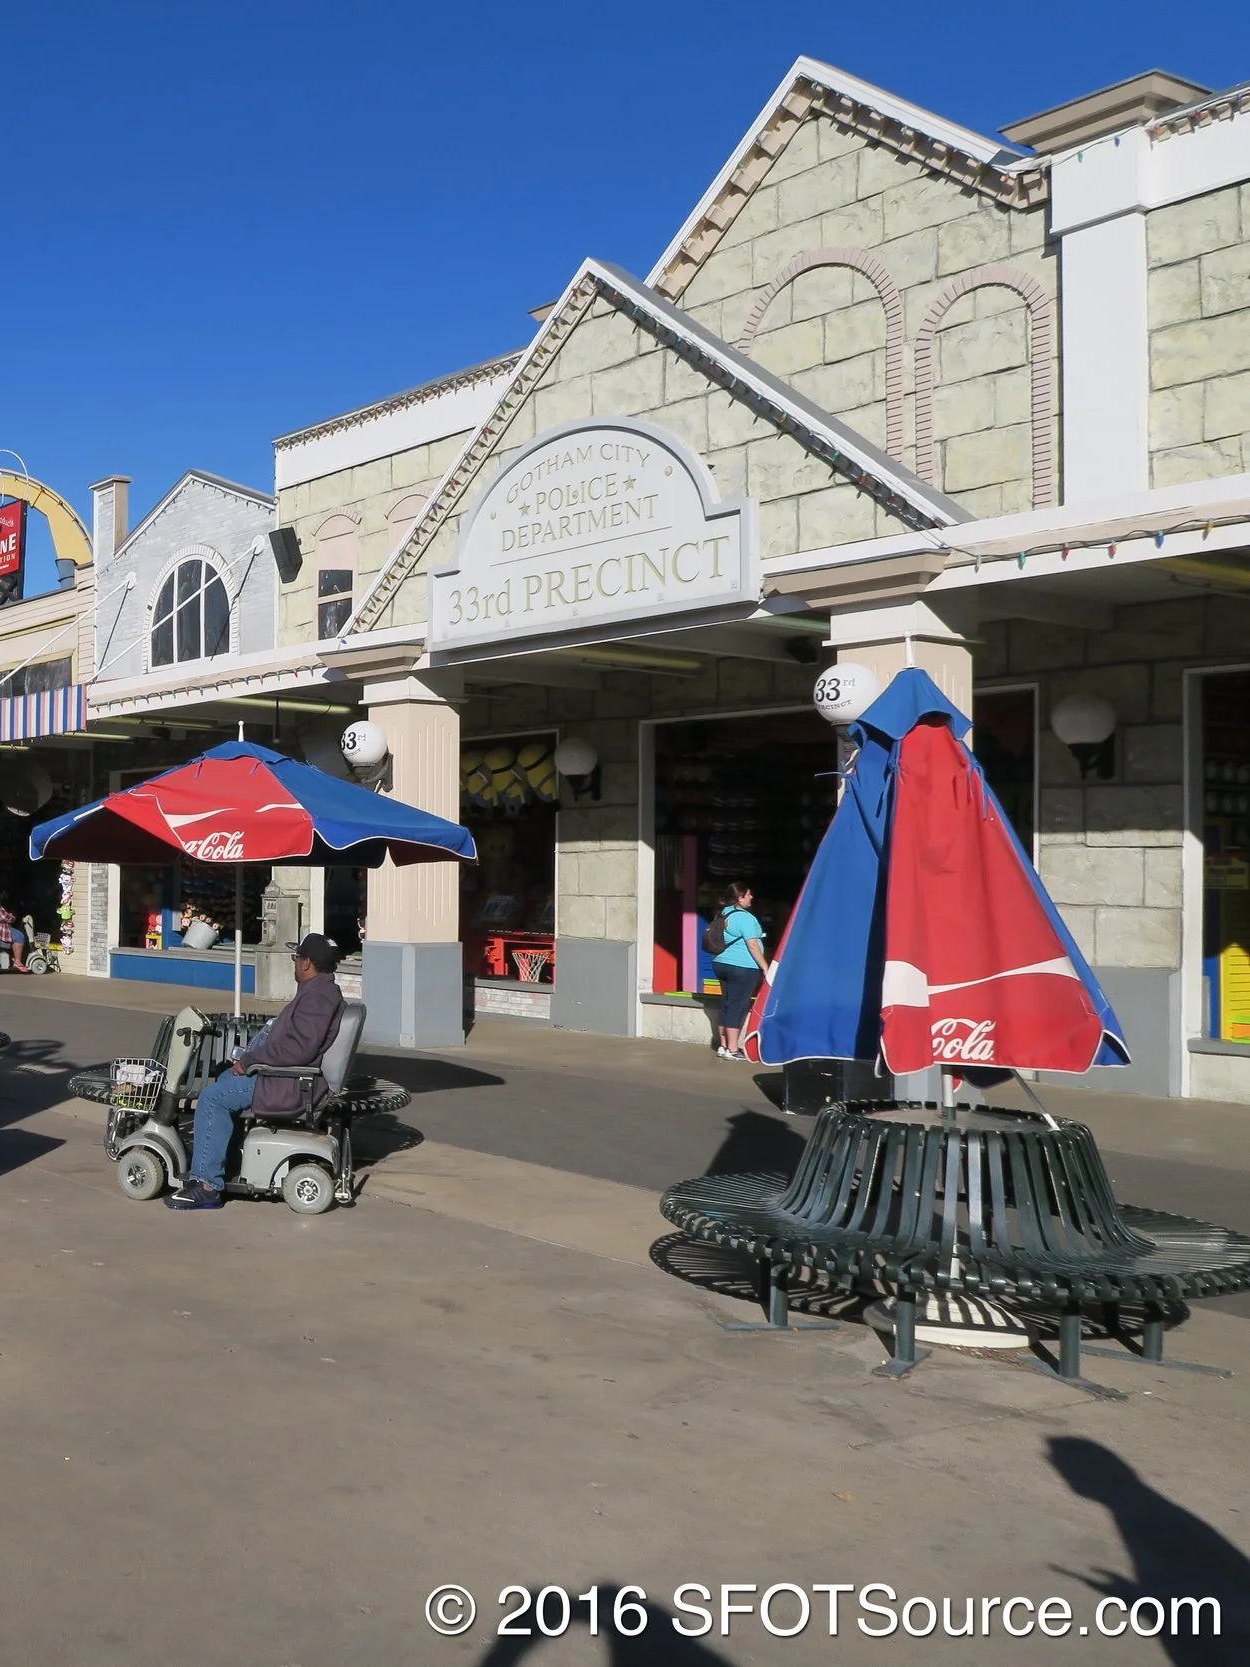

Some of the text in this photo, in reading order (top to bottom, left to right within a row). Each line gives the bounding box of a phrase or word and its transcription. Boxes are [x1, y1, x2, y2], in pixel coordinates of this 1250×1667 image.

[506, 443, 651, 505] GOTHAM CITY
[535, 472, 618, 515] POLICE
[501, 493, 659, 552] DEPARTMENT
[449, 535, 730, 625] 33rd PRECINCT
